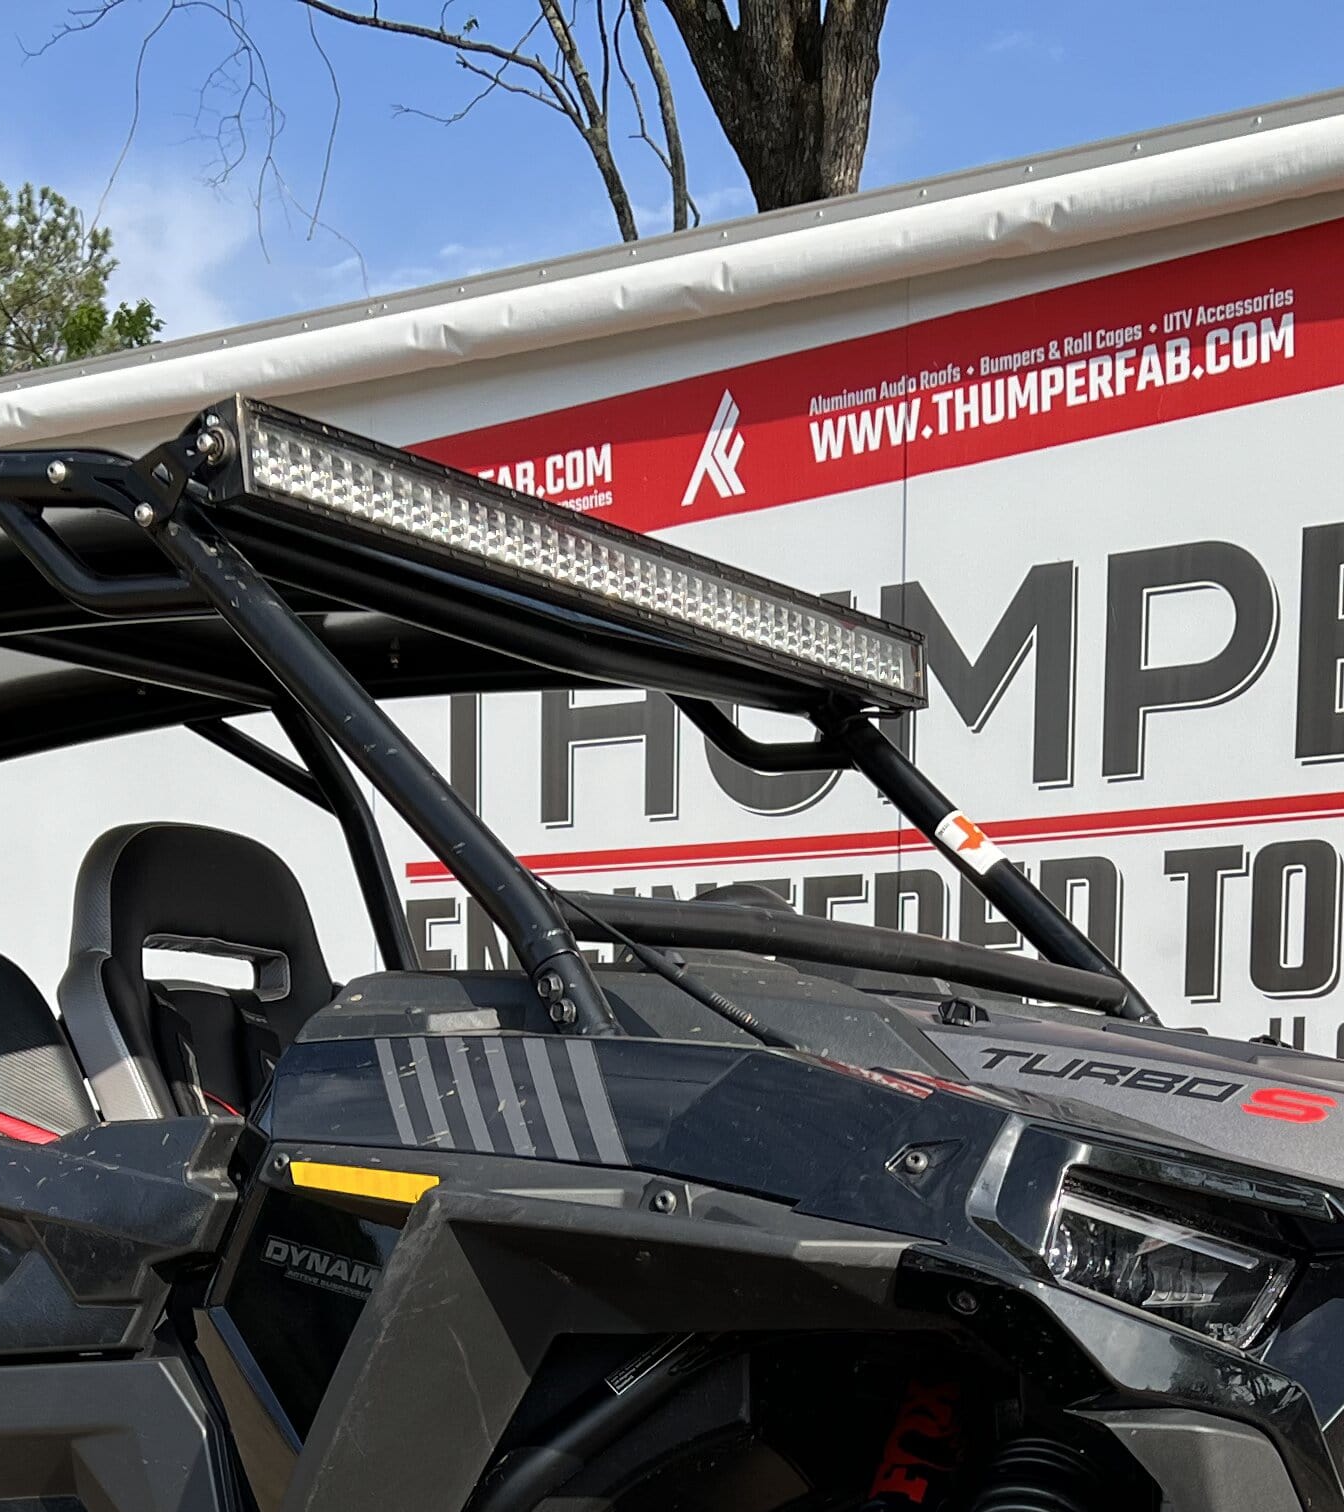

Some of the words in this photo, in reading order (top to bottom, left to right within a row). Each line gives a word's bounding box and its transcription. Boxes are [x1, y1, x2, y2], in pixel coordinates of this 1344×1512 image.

[808, 311, 1296, 464] WWW.THUMPERFAB.COM
[809, 386, 877, 418] Aluminum
[919, 362, 962, 391] Roofs
[979, 346, 1046, 377] Bumpers
[1048, 340, 1063, 361] &
[1063, 330, 1093, 357] Roll
[1096, 322, 1144, 350] Cages
[1163, 308, 1194, 334] UTV
[1196, 287, 1296, 326] Accessories
[1163, 837, 1344, 1003] TO
[979, 1046, 1246, 1104] TURBO
[1240, 1086, 1340, 1125] S
